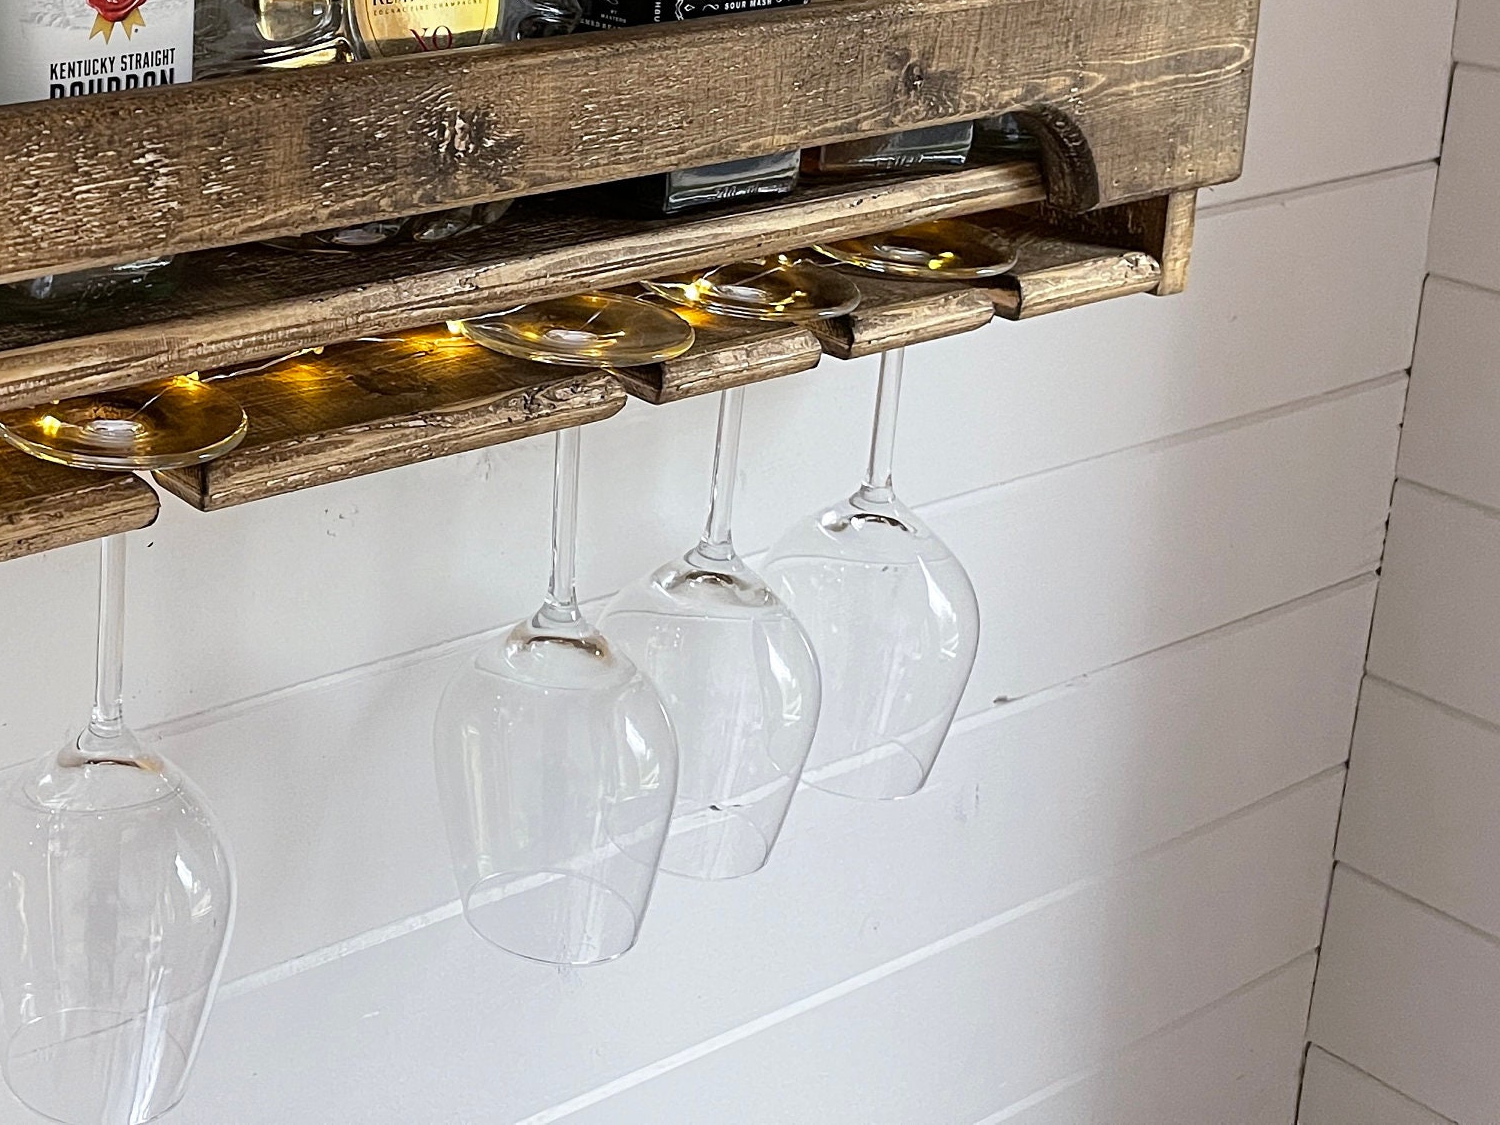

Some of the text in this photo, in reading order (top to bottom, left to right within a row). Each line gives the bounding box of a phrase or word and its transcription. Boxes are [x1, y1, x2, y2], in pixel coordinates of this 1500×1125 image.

[724, 1, 746, 12] SOUR
[409, 25, 454, 52] XO
[50, 47, 176, 81] KENTUCKY STRAIGHT
